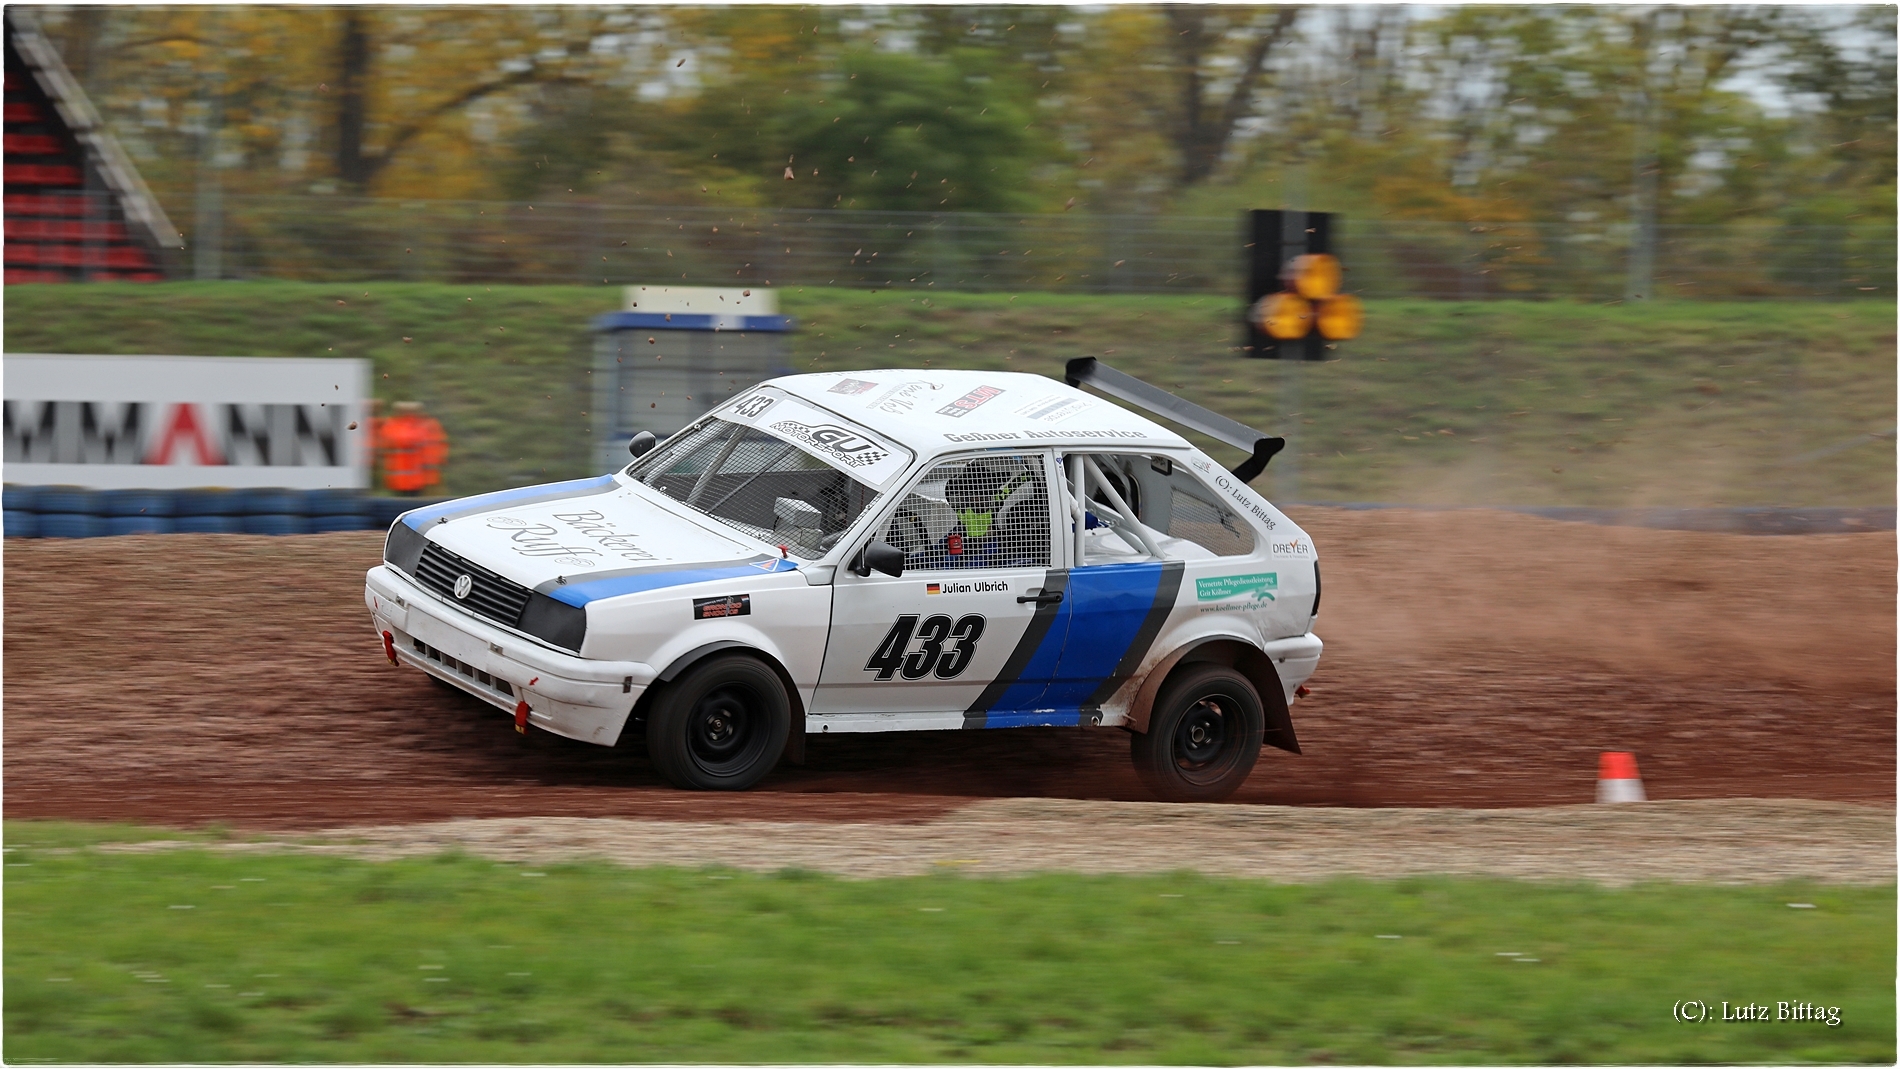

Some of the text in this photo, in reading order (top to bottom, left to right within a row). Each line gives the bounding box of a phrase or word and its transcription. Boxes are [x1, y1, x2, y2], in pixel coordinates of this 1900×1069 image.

[734, 395, 774, 418] 433
[811, 428, 873, 453] GU
[943, 428, 1147, 443] Geßner Autoservice
[769, 422, 866, 469] MOTORSPORT
[486, 523, 604, 557] Ruff
[552, 510, 673, 561] Bäckerei
[1272, 539, 1309, 554] DREYER
[942, 581, 1008, 594] Julian Ulbrich
[1198, 576, 1274, 588] Vernetzte Pflegedienstleistung
[1211, 588, 1232, 596] Köllmer
[1200, 601, 1268, 613] www.koellmer-pflege.de
[863, 613, 988, 682] 433
